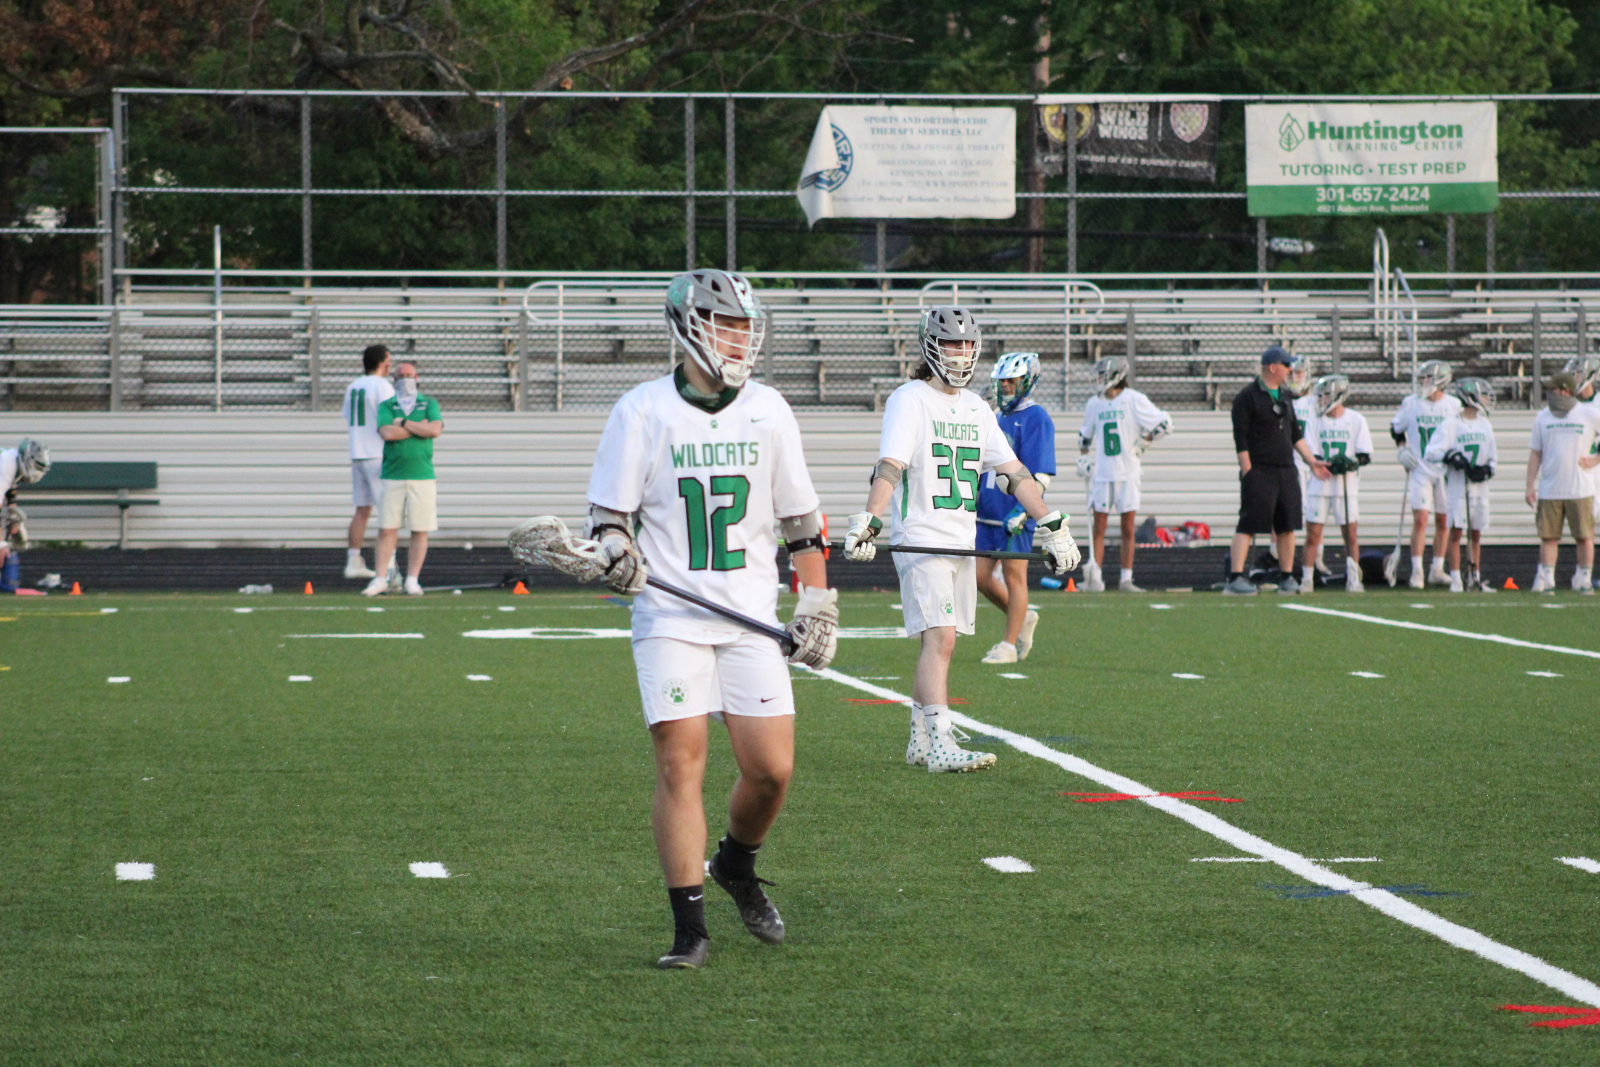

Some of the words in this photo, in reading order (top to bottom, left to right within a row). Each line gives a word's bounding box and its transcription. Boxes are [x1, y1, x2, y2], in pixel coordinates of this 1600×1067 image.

[864, 116, 899, 125] SPORTS
[903, 116, 921, 125] AND
[1100, 111, 1149, 126] WILD
[870, 127, 915, 136] THERAPY
[965, 128, 983, 137] LLC
[1098, 124, 1149, 140] WINGS
[1307, 120, 1464, 145] Huntington
[924, 143, 964, 152] PHYSICAL
[1329, 141, 1398, 152] LEARNING
[1415, 140, 1464, 151] CENTER
[1279, 163, 1364, 177] TUTORING
[1377, 163, 1418, 176] TEST
[1422, 162, 1467, 175] PREP
[1316, 186, 1431, 203] 301-657-2424
[350, 388, 366, 427] 11
[1098, 410, 1125, 421] WILDCATS
[932, 420, 979, 441] WILDCATS
[1319, 430, 1351, 440] WILDCATS
[1103, 422, 1121, 456] 6
[670, 441, 759, 468] WILDCATS
[1464, 444, 1479, 468] 7
[931, 443, 981, 512] 35
[678, 474, 750, 571] 12
